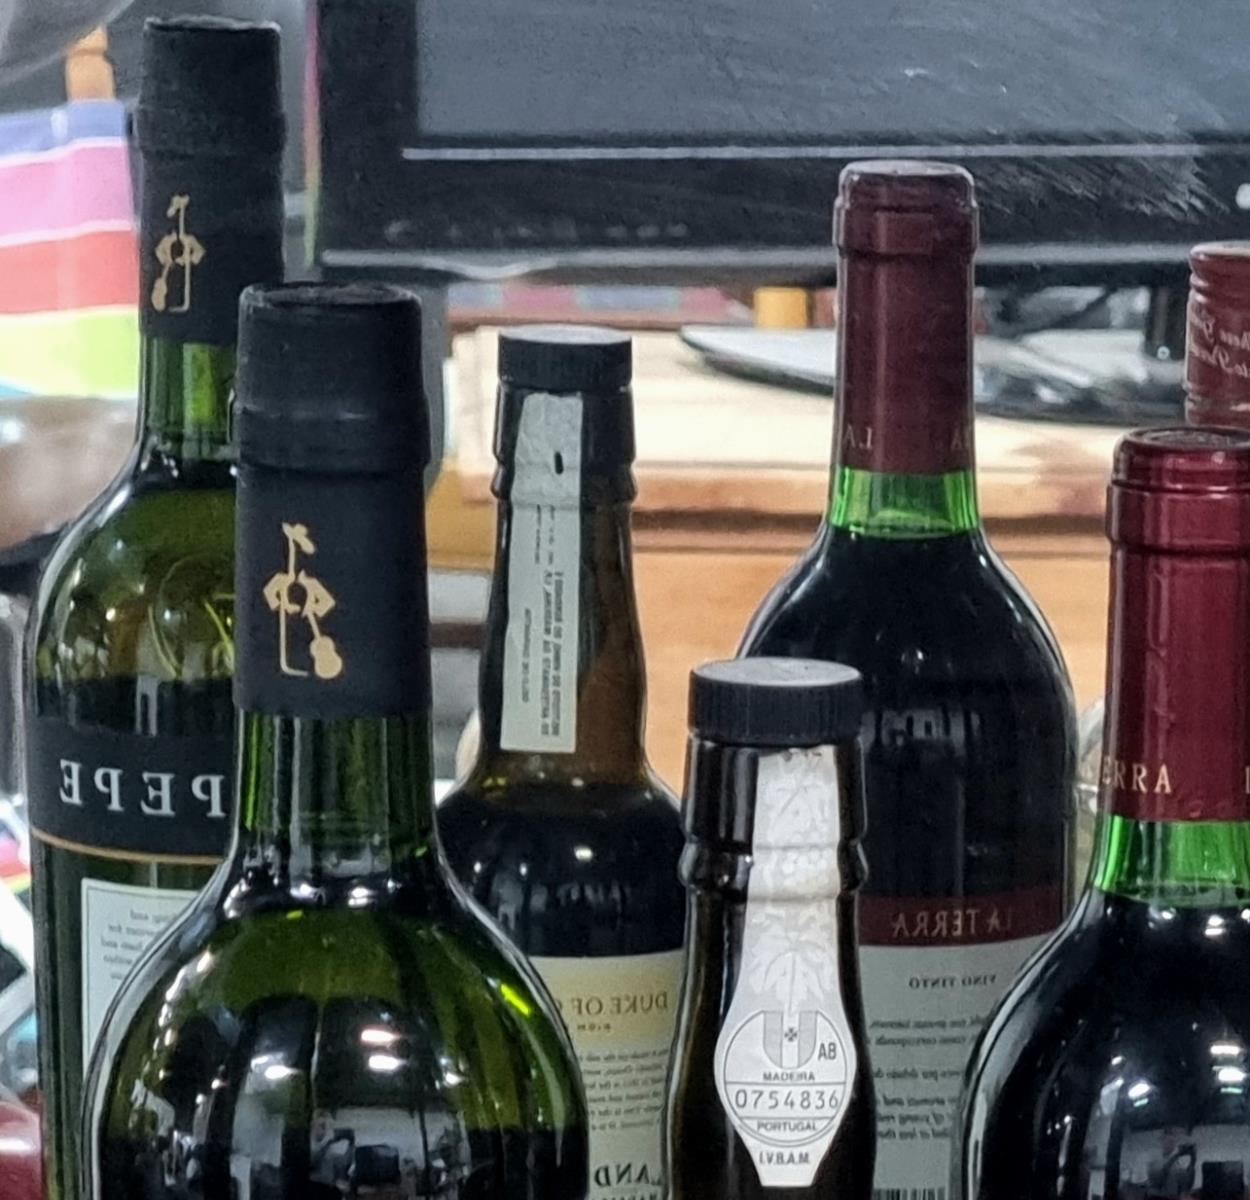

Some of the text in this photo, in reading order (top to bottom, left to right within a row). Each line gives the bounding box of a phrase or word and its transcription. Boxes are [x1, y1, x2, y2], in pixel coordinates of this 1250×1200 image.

[817, 1042, 837, 1061] AB
[762, 1071, 816, 1081] MADEIRA
[735, 1089, 839, 1109] 0754836
[757, 1121, 818, 1132] PORTUGAL
